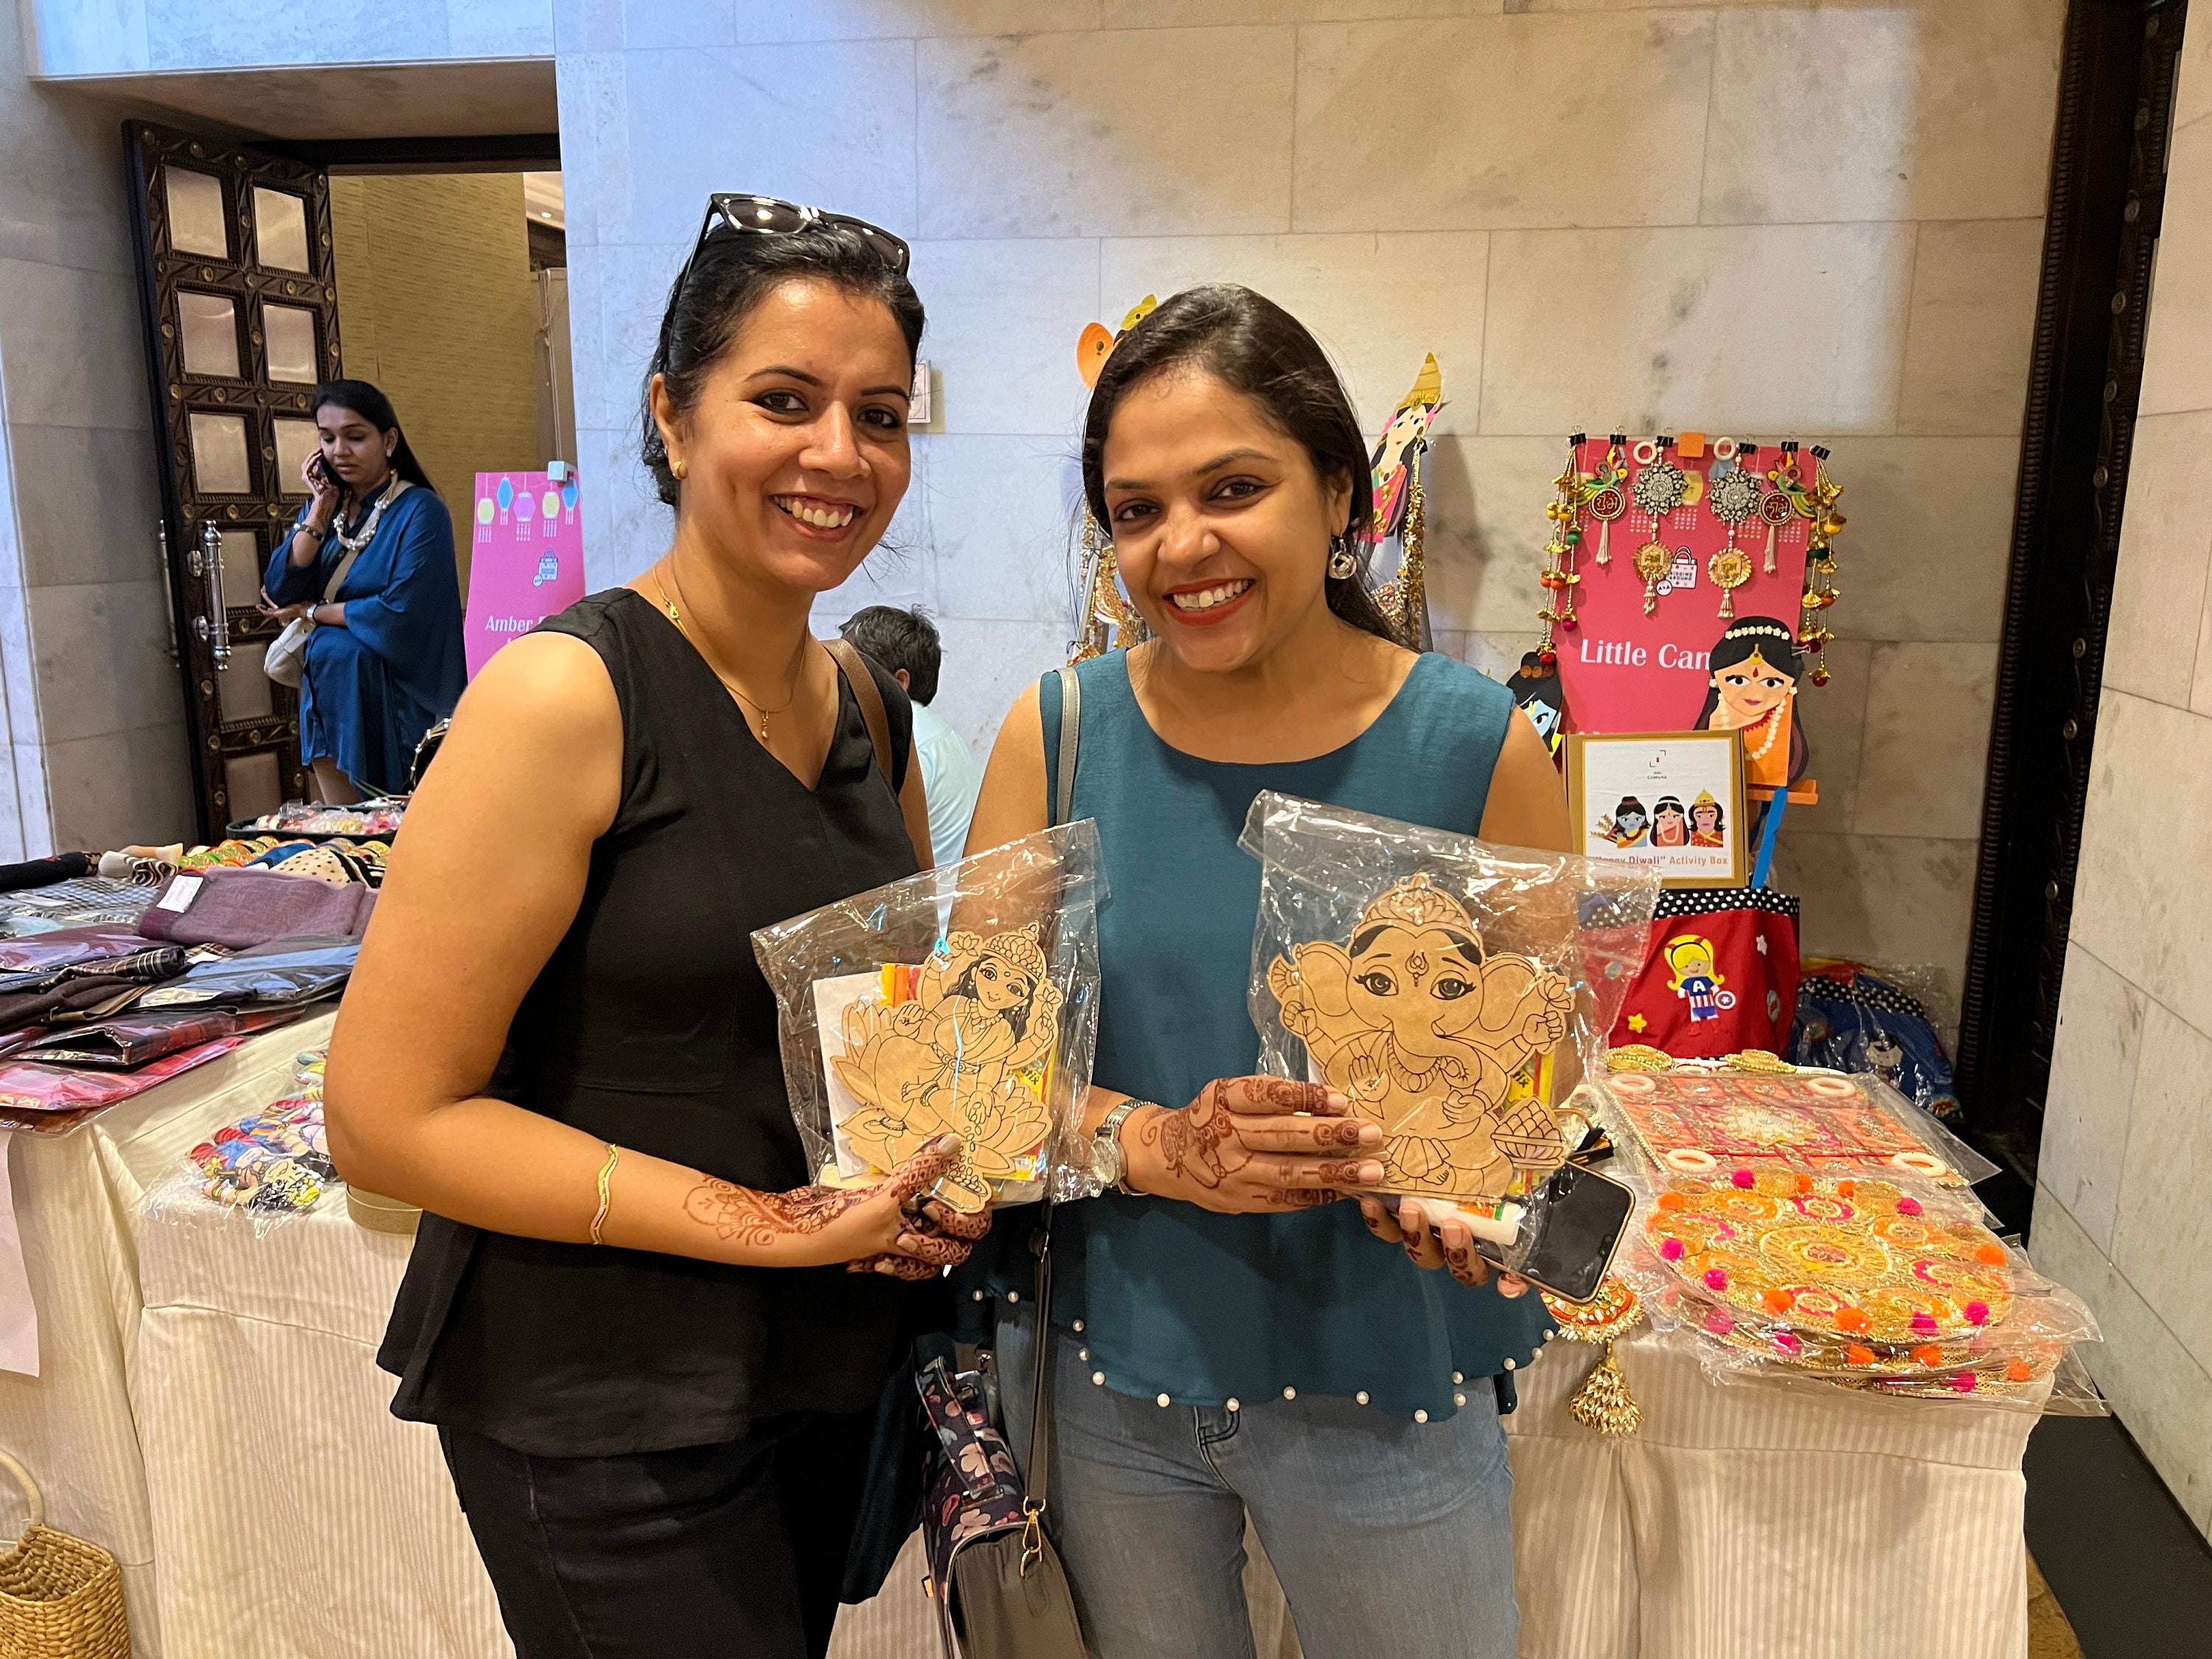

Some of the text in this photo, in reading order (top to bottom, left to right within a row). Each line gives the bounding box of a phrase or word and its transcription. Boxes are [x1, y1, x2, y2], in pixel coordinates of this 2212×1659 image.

[485, 615, 533, 633] Amber
[1581, 639, 1646, 667] Little
[1669, 855, 1706, 866] Activity
[1710, 855, 1728, 864] Box
[1692, 980, 1707, 993] A
